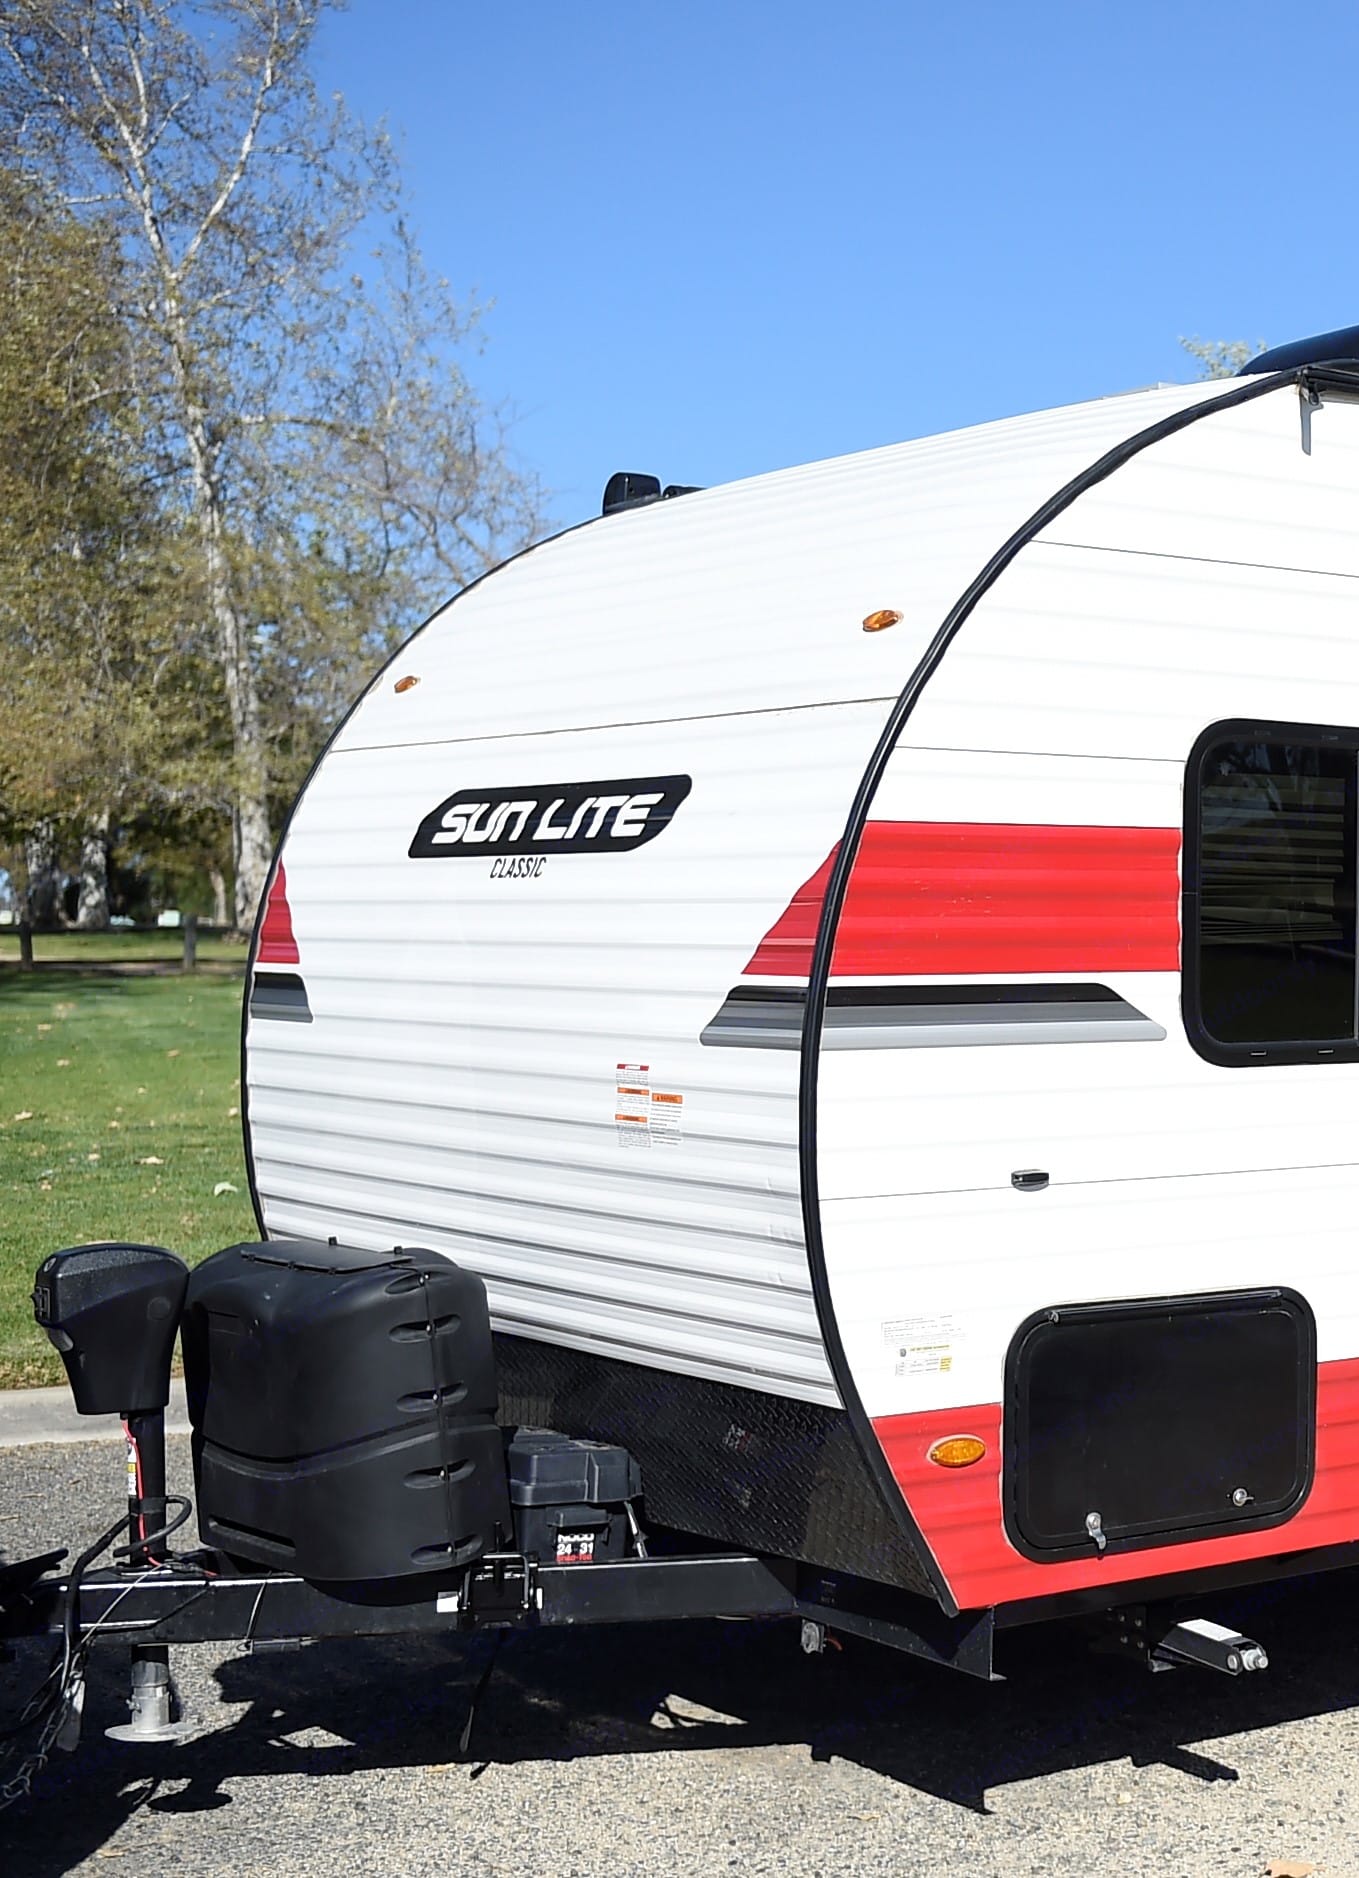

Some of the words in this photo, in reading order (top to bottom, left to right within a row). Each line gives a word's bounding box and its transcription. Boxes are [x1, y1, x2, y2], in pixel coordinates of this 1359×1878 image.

[431, 800, 538, 844] SUN
[532, 792, 665, 840] LITE
[489, 856, 547, 879] CLASSIC
